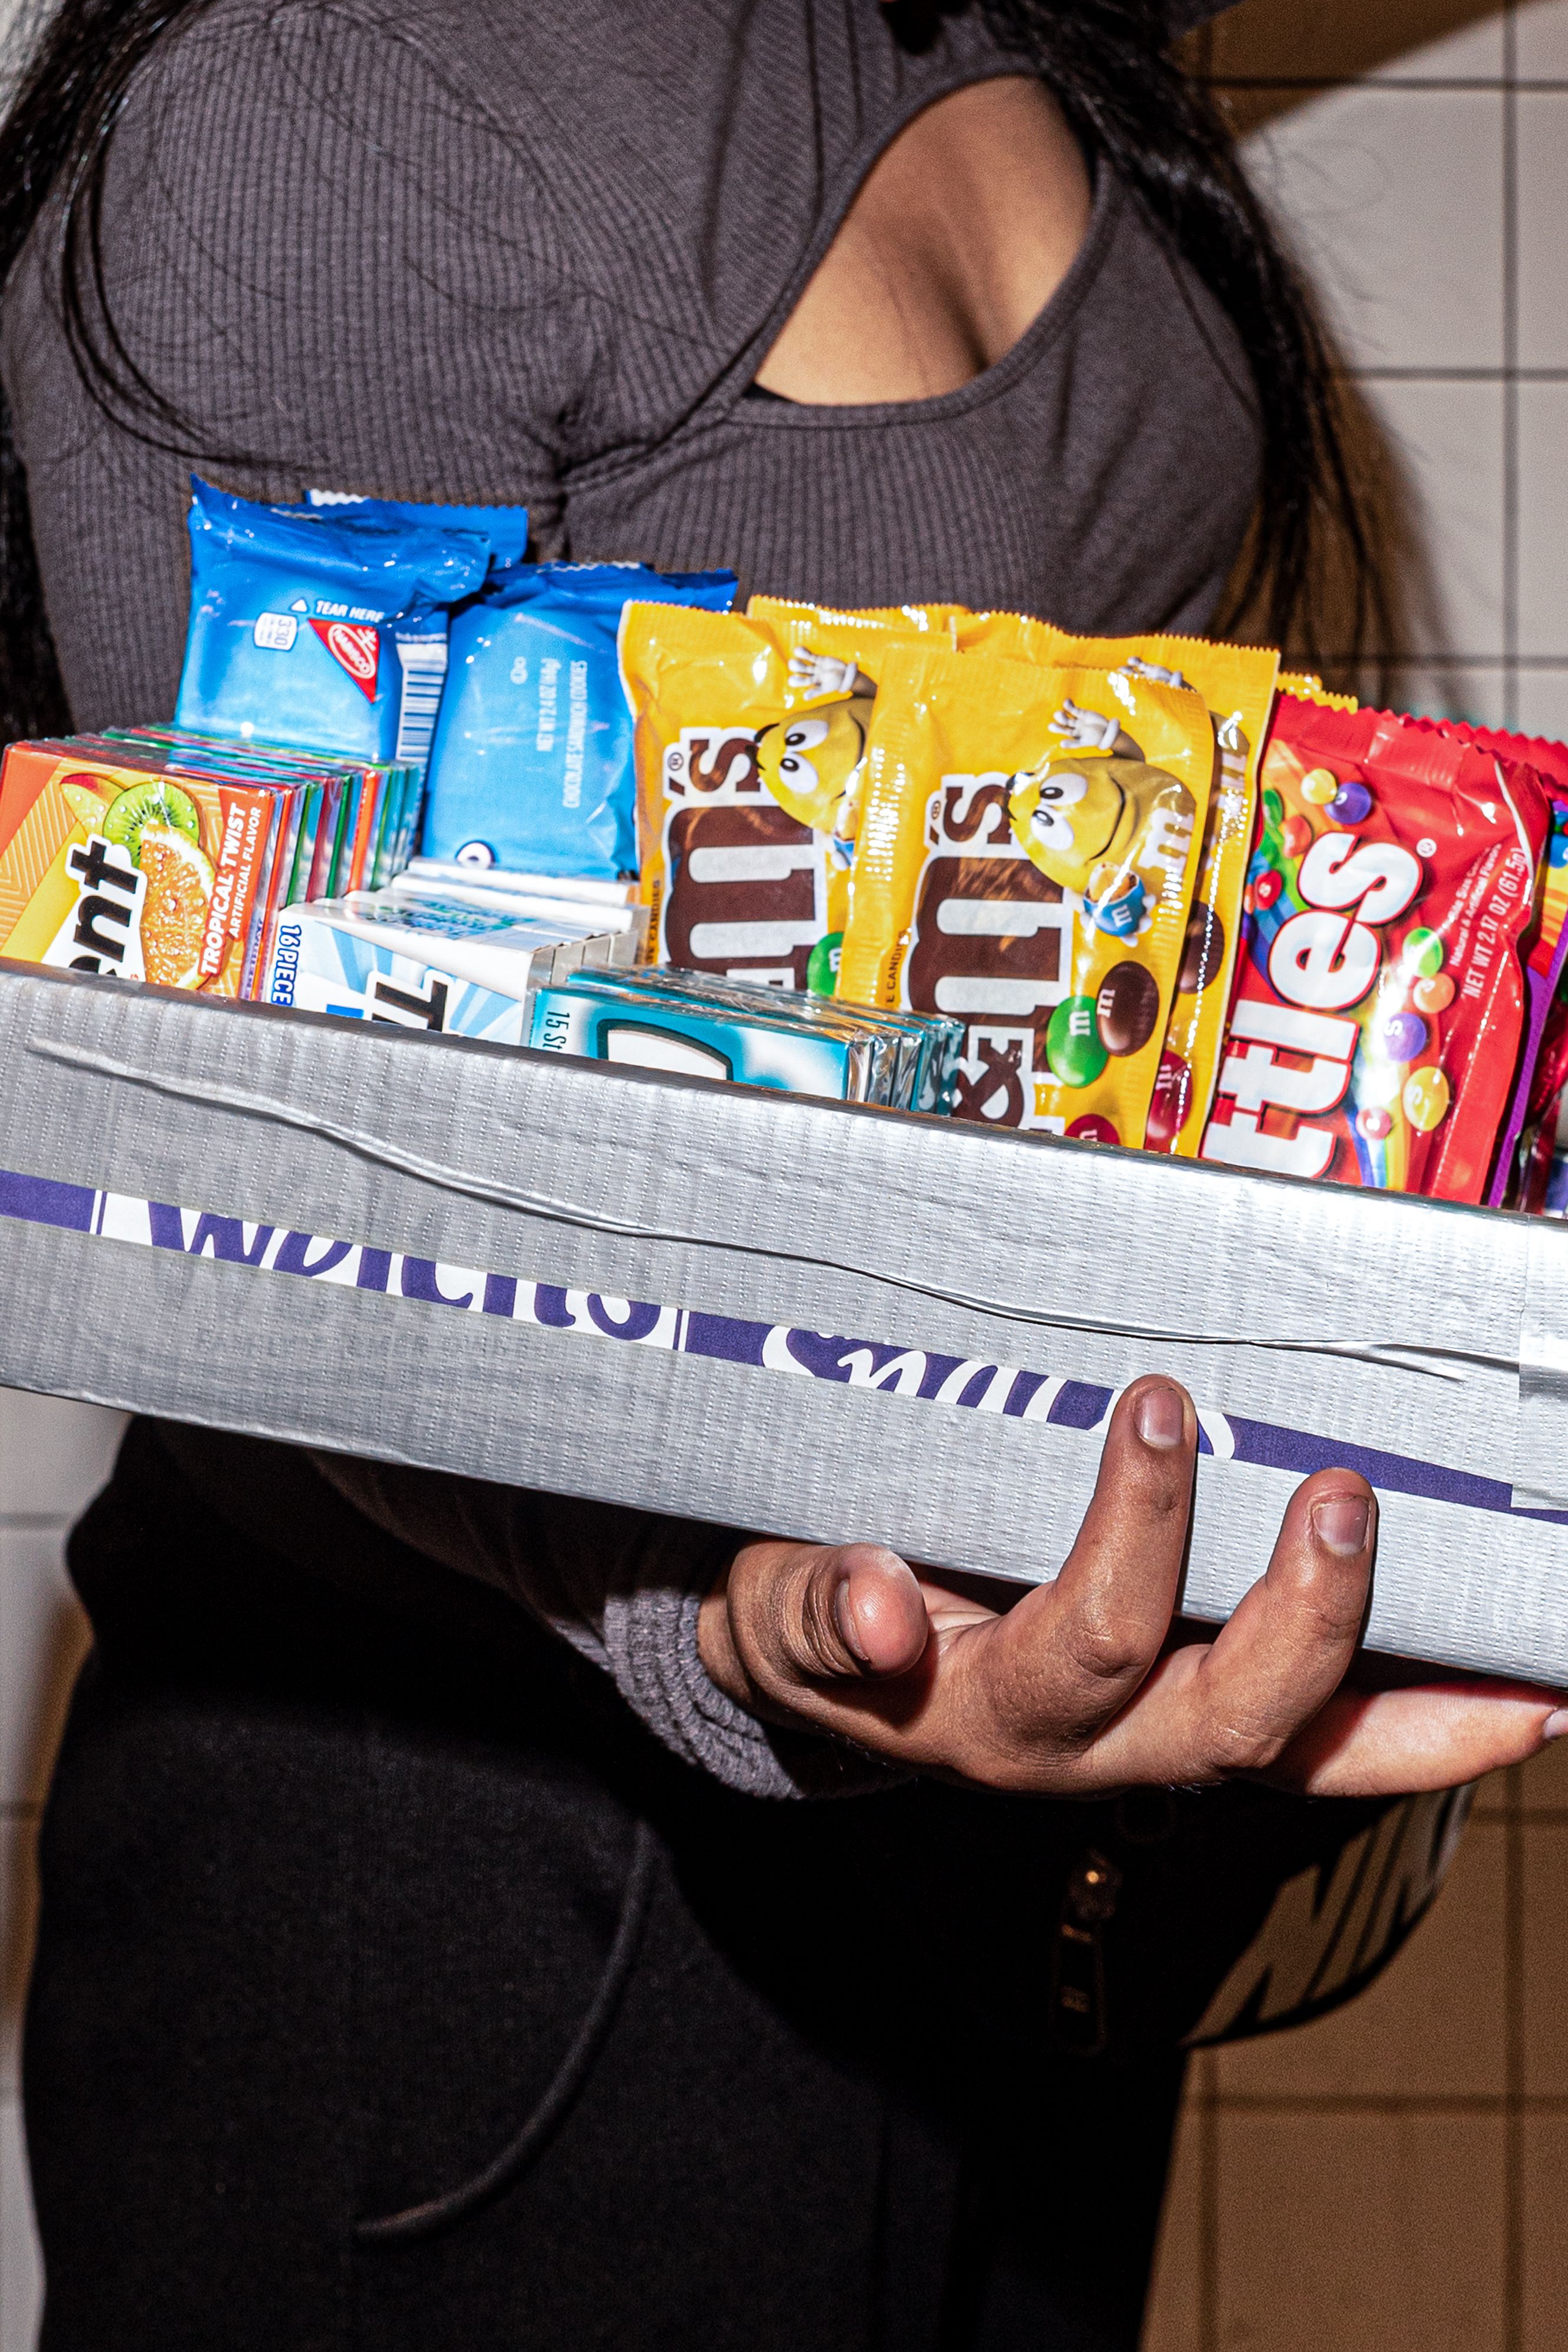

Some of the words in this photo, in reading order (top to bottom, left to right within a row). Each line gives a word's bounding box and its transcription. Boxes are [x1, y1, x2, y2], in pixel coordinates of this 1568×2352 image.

[316, 600, 348, 617] TEAR
[274, 619, 292, 646] 330
[228, 864, 252, 939] ARTIFICIAL
[242, 806, 262, 861] FLAVOR
[200, 874, 234, 974] TROPICAL
[220, 802, 246, 867] TWIST
[1489, 894, 1512, 916] OZ
[279, 924, 302, 947] 16
[1477, 914, 1499, 945] 2.17
[1449, 927, 1469, 967] Natural
[1472, 943, 1493, 968] WT
[271, 947, 299, 1007] PIECE
[1462, 968, 1486, 998] NET
[1097, 988, 1116, 1017] m
[546, 1011, 570, 1030] 15
[1068, 1010, 1090, 1037] m
